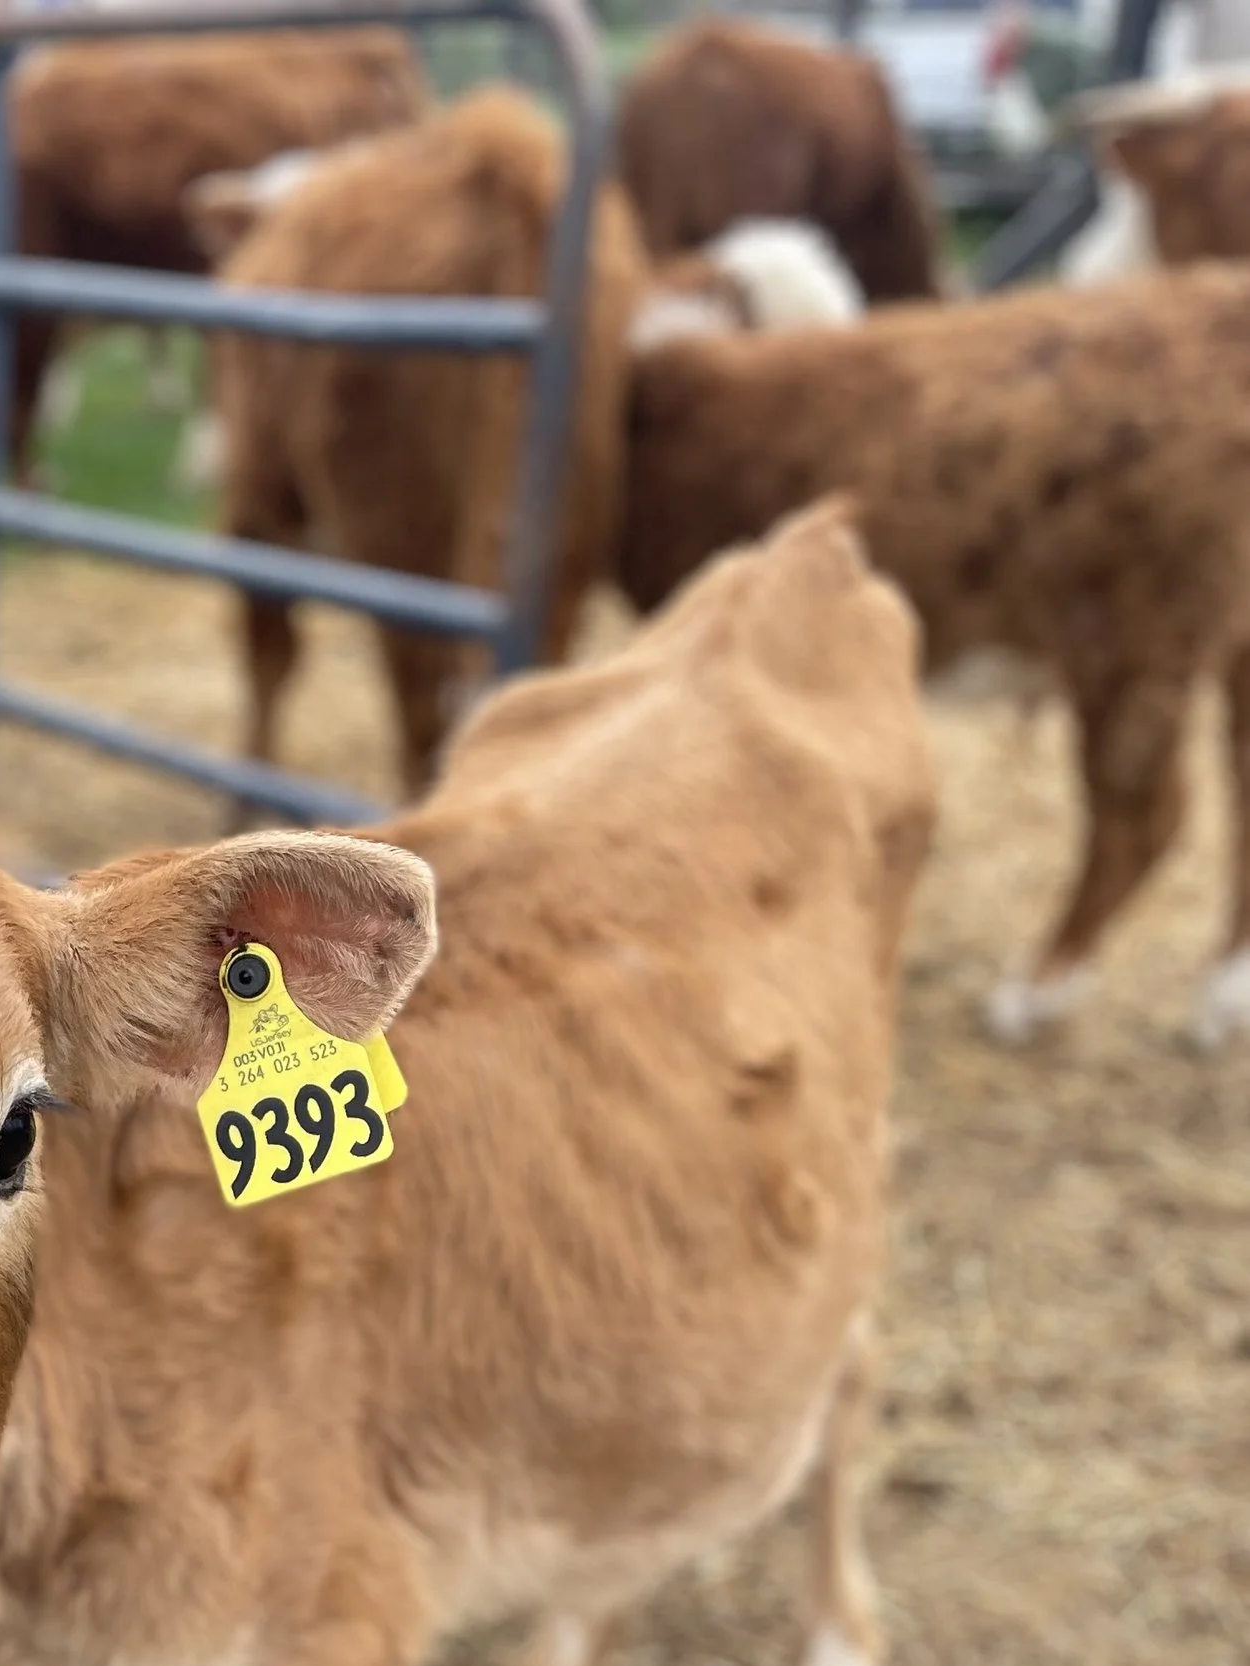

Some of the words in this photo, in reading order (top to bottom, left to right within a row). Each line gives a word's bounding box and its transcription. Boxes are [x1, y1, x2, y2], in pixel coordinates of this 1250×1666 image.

[218, 1077, 229, 1092] 3
[238, 1065, 265, 1087] 264
[273, 1052, 301, 1074] 023
[309, 1040, 337, 1061] 523
[216, 1070, 384, 1200] 9393
